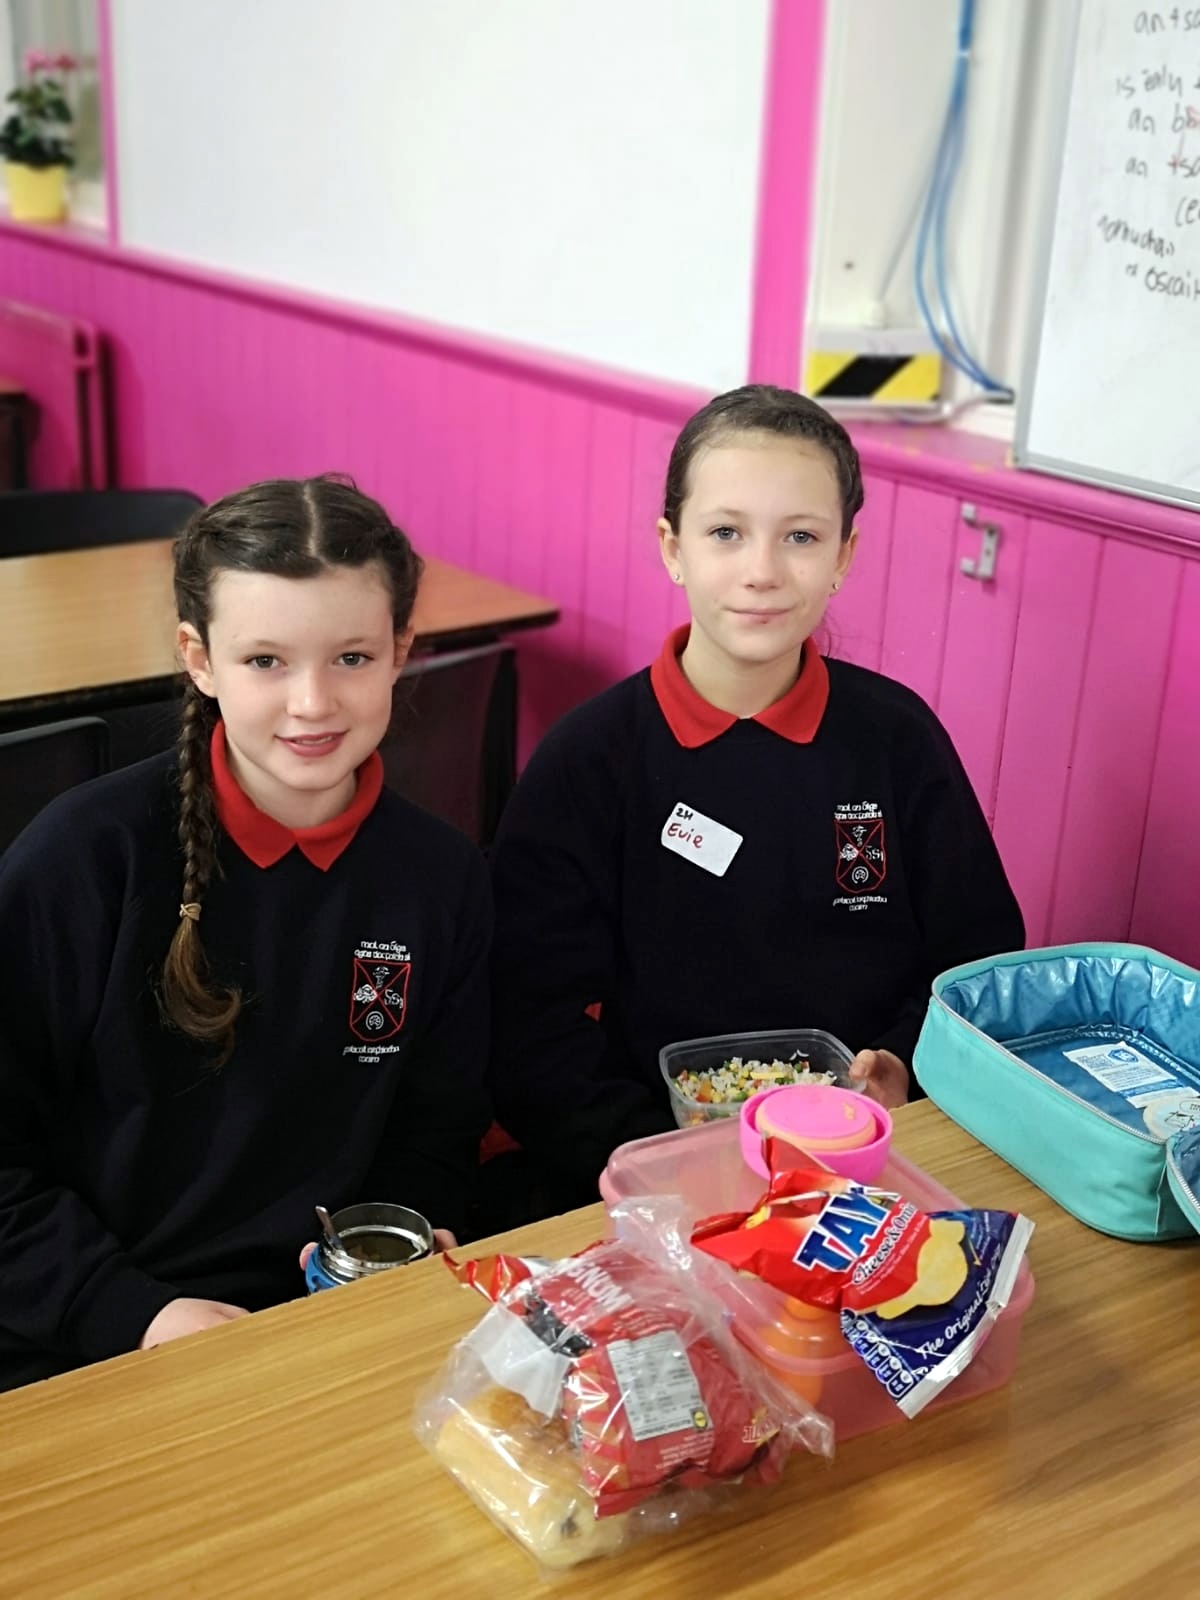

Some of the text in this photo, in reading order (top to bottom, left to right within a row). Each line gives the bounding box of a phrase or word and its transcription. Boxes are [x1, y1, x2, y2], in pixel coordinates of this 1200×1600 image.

[667, 822, 703, 848] Evie
[792, 1187, 893, 1272] TAY
[852, 1235, 896, 1284] Cheese
[918, 1337, 945, 1360] The
[944, 1291, 984, 1339] Original
